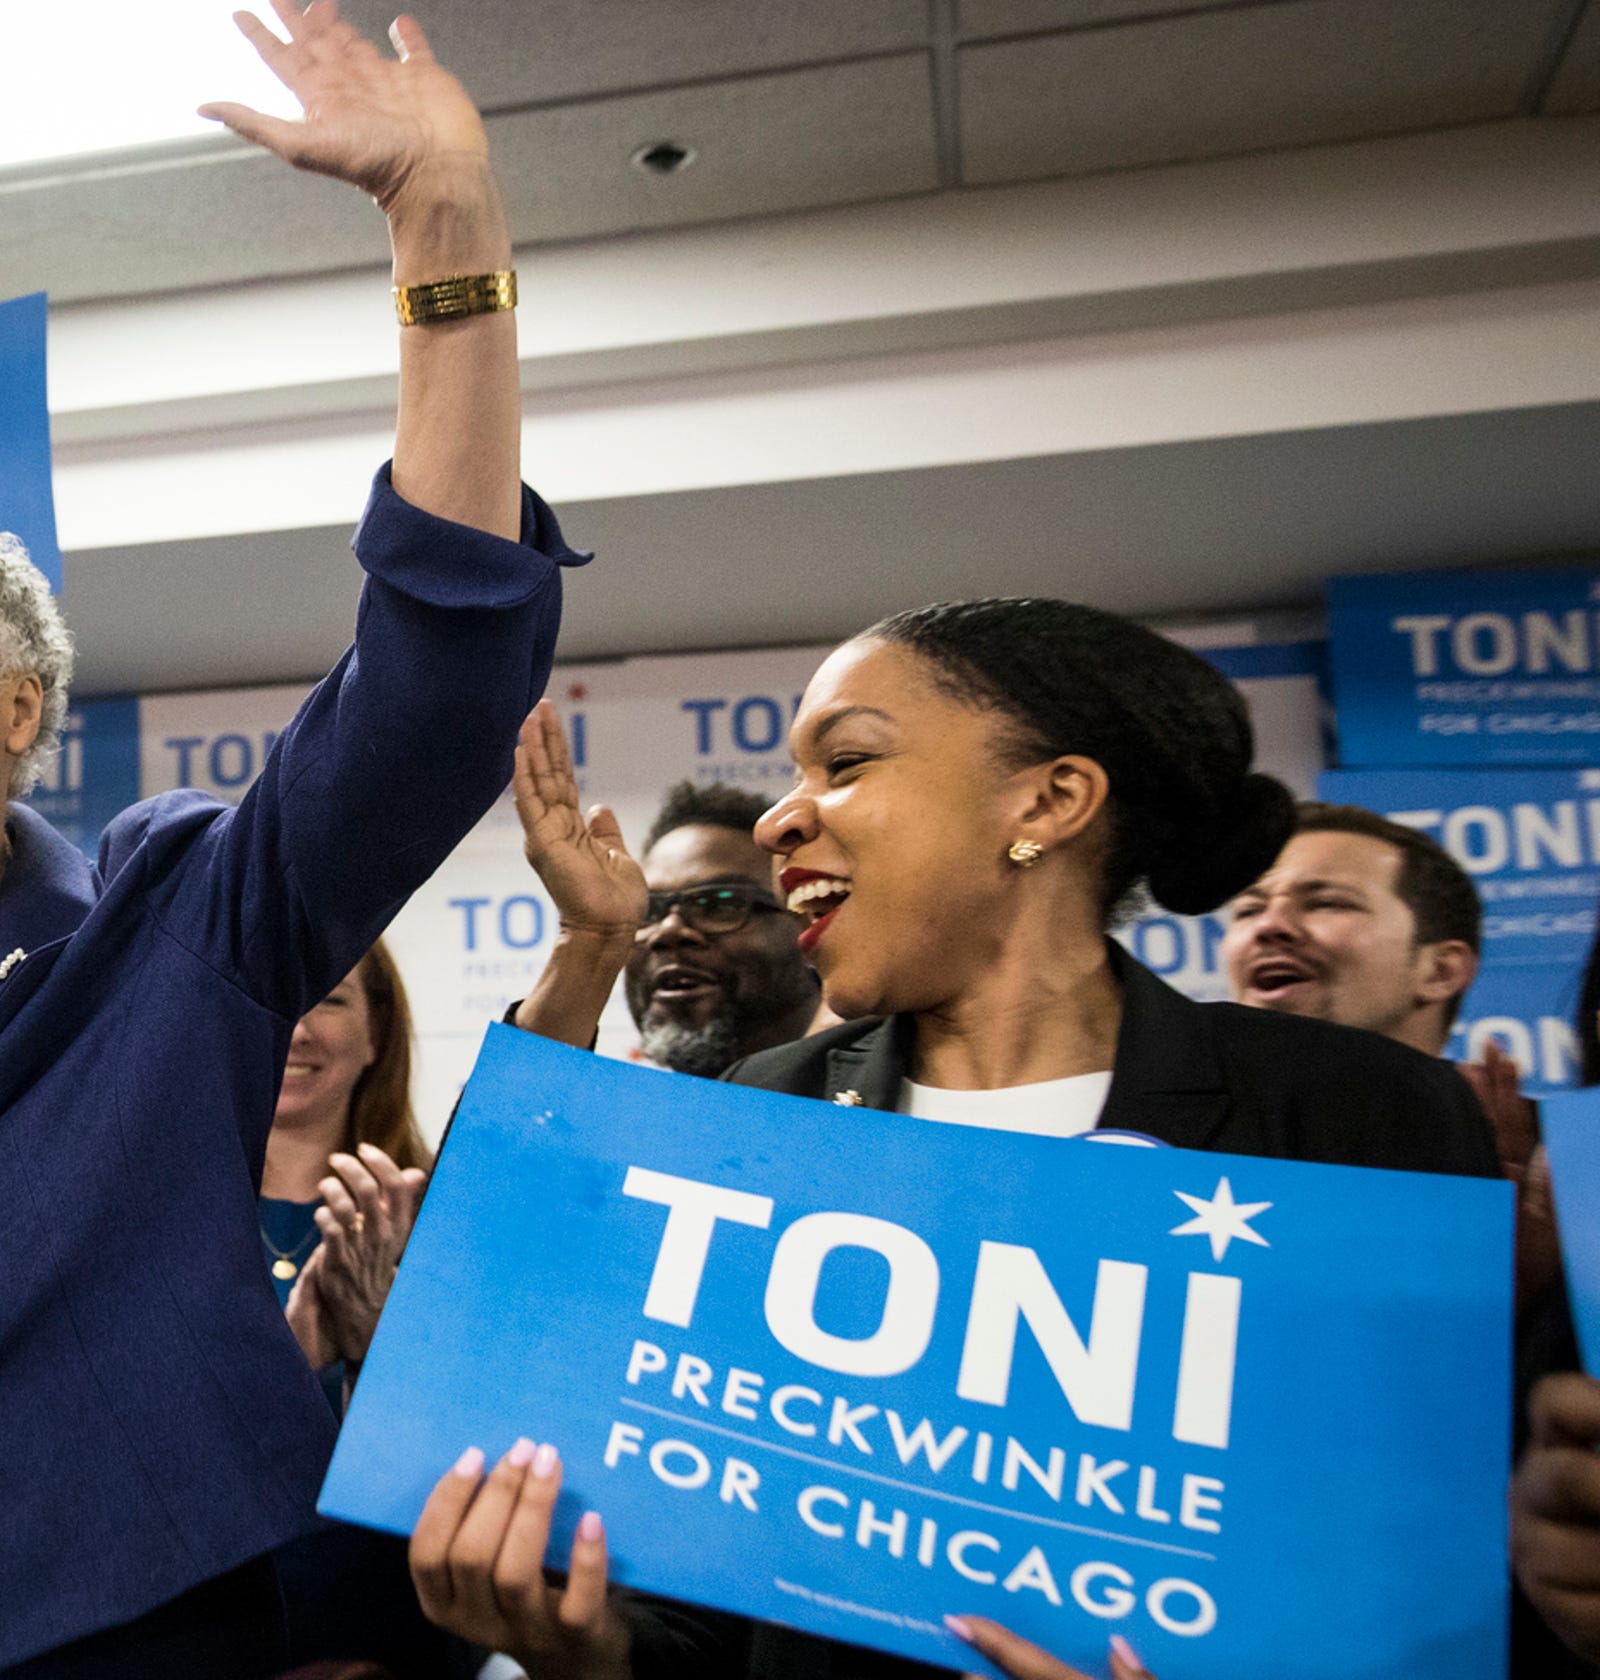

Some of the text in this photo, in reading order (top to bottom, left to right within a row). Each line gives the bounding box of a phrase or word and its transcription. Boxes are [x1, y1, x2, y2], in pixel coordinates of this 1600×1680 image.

[681, 696, 806, 755] TO
[603, 1421, 760, 1512] FOR
[797, 1486, 1217, 1637] CHICAGO
[626, 1340, 1224, 1534] PRECKWINKLE
